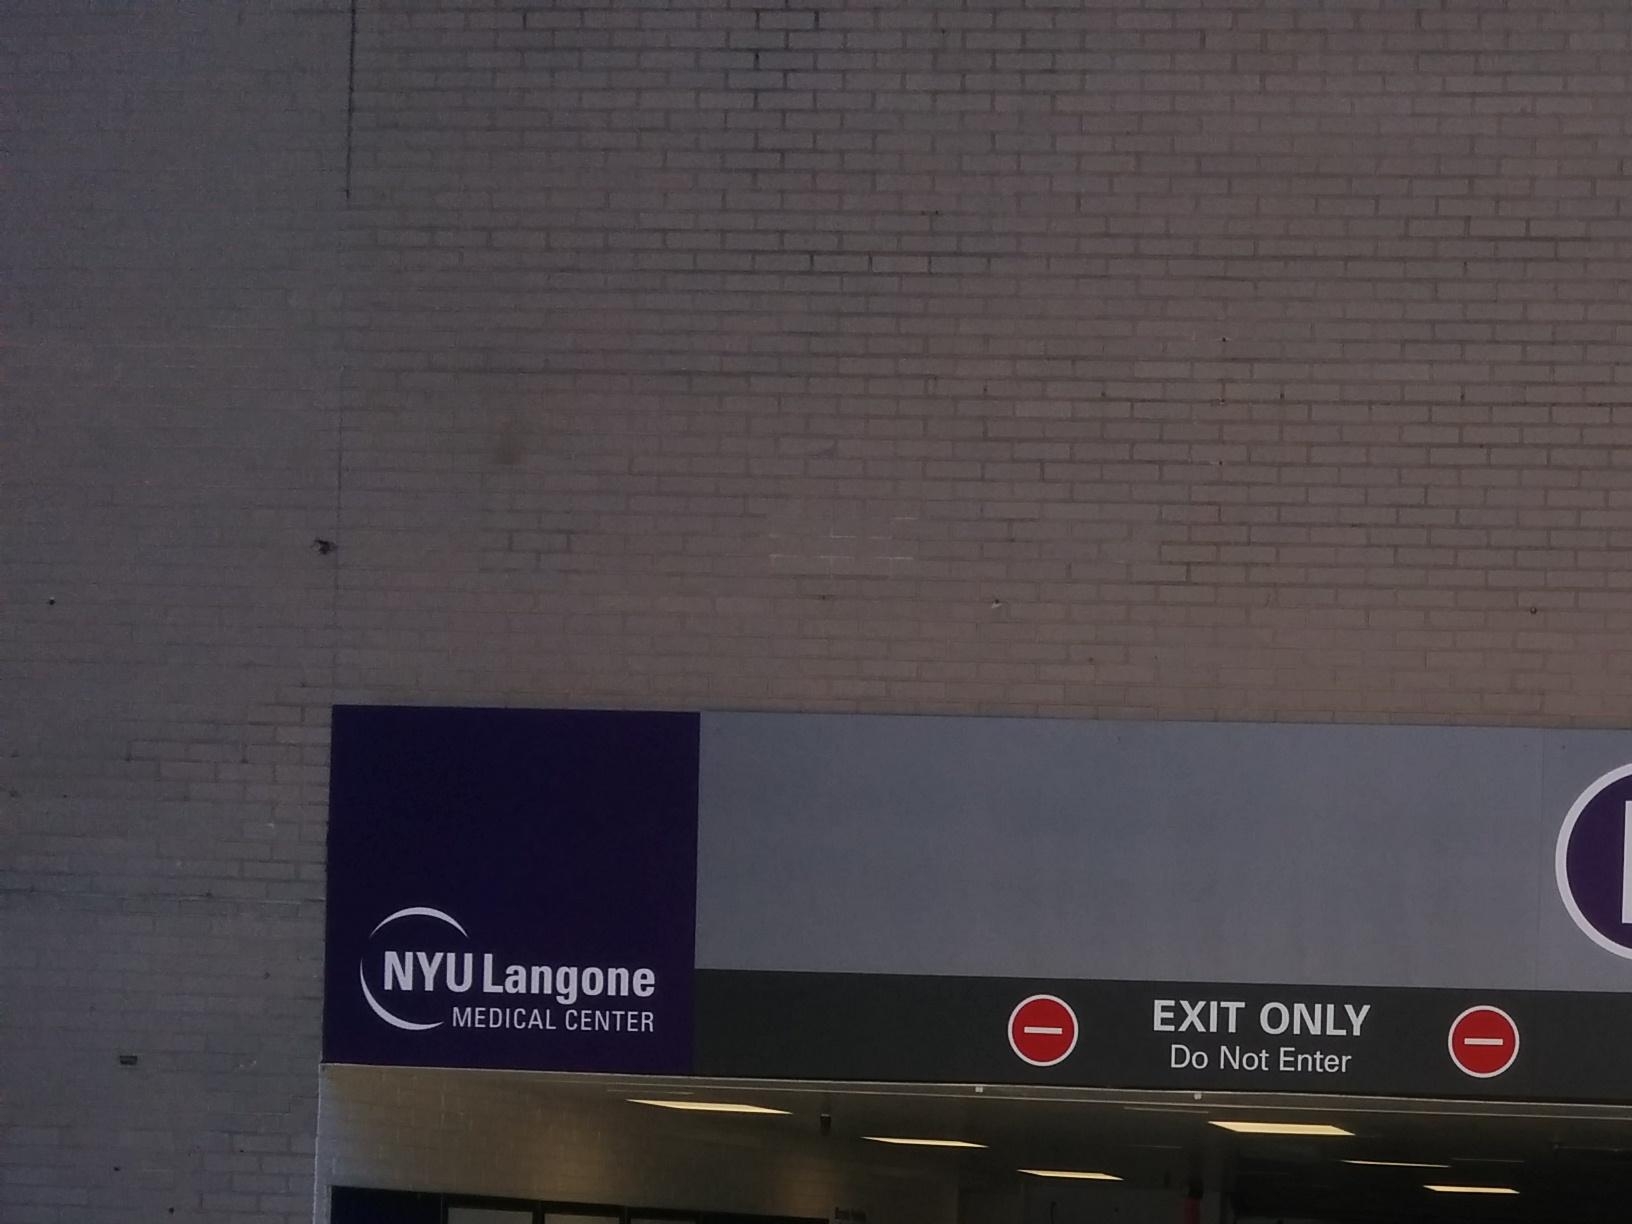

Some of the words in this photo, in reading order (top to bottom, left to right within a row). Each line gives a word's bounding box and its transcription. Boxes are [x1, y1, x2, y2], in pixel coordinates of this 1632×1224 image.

[383, 950, 473, 993] NYU
[483, 953, 655, 1004] Langone
[452, 1006, 556, 1031] MEDICAL
[565, 1007, 654, 1033] CENTER
[1153, 1000, 1245, 1033] EXIT
[1260, 1002, 1371, 1036] ONLY
[1170, 1045, 1208, 1069] Do
[1219, 1046, 1269, 1071] Not
[1280, 1047, 1352, 1073] Enter
